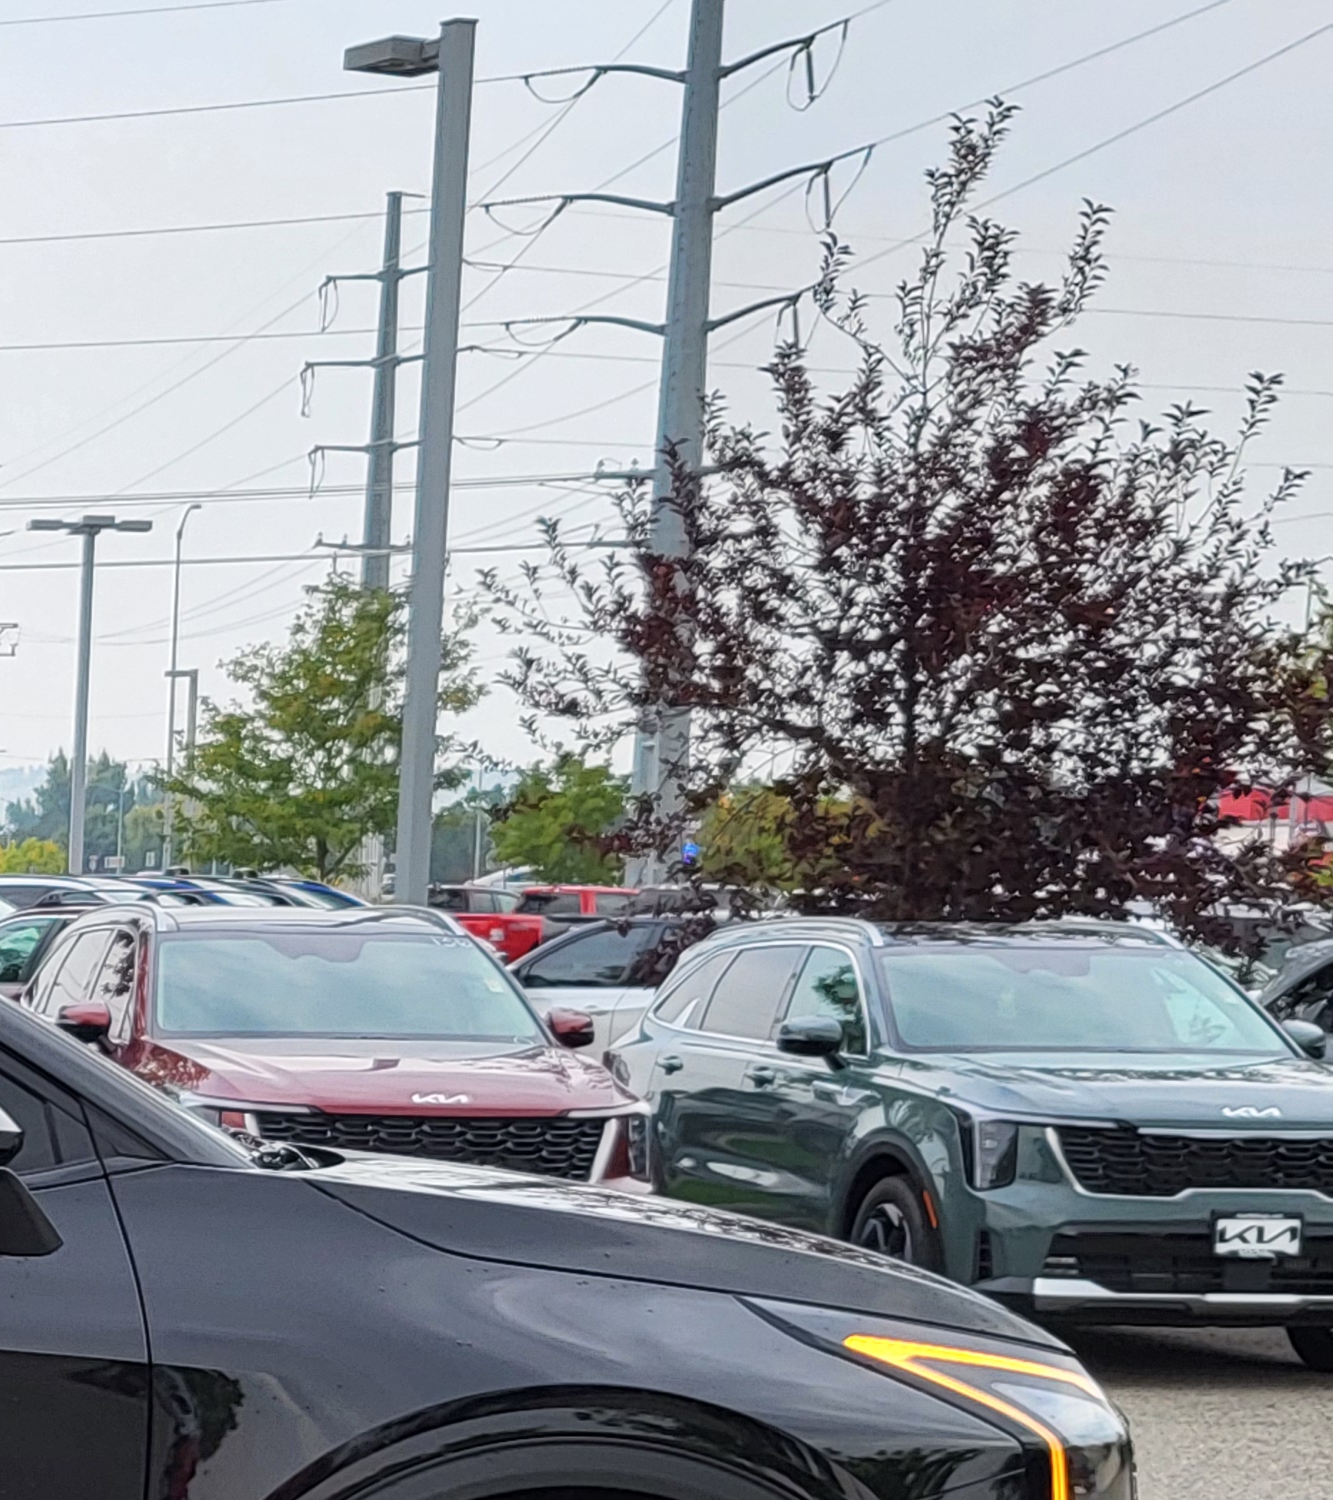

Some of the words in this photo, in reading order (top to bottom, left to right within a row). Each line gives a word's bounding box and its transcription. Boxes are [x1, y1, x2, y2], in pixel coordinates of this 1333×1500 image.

[411, 1093, 469, 1104] KIA
[1221, 1106, 1283, 1118] KIA
[1217, 1224, 1299, 1245] KIA
